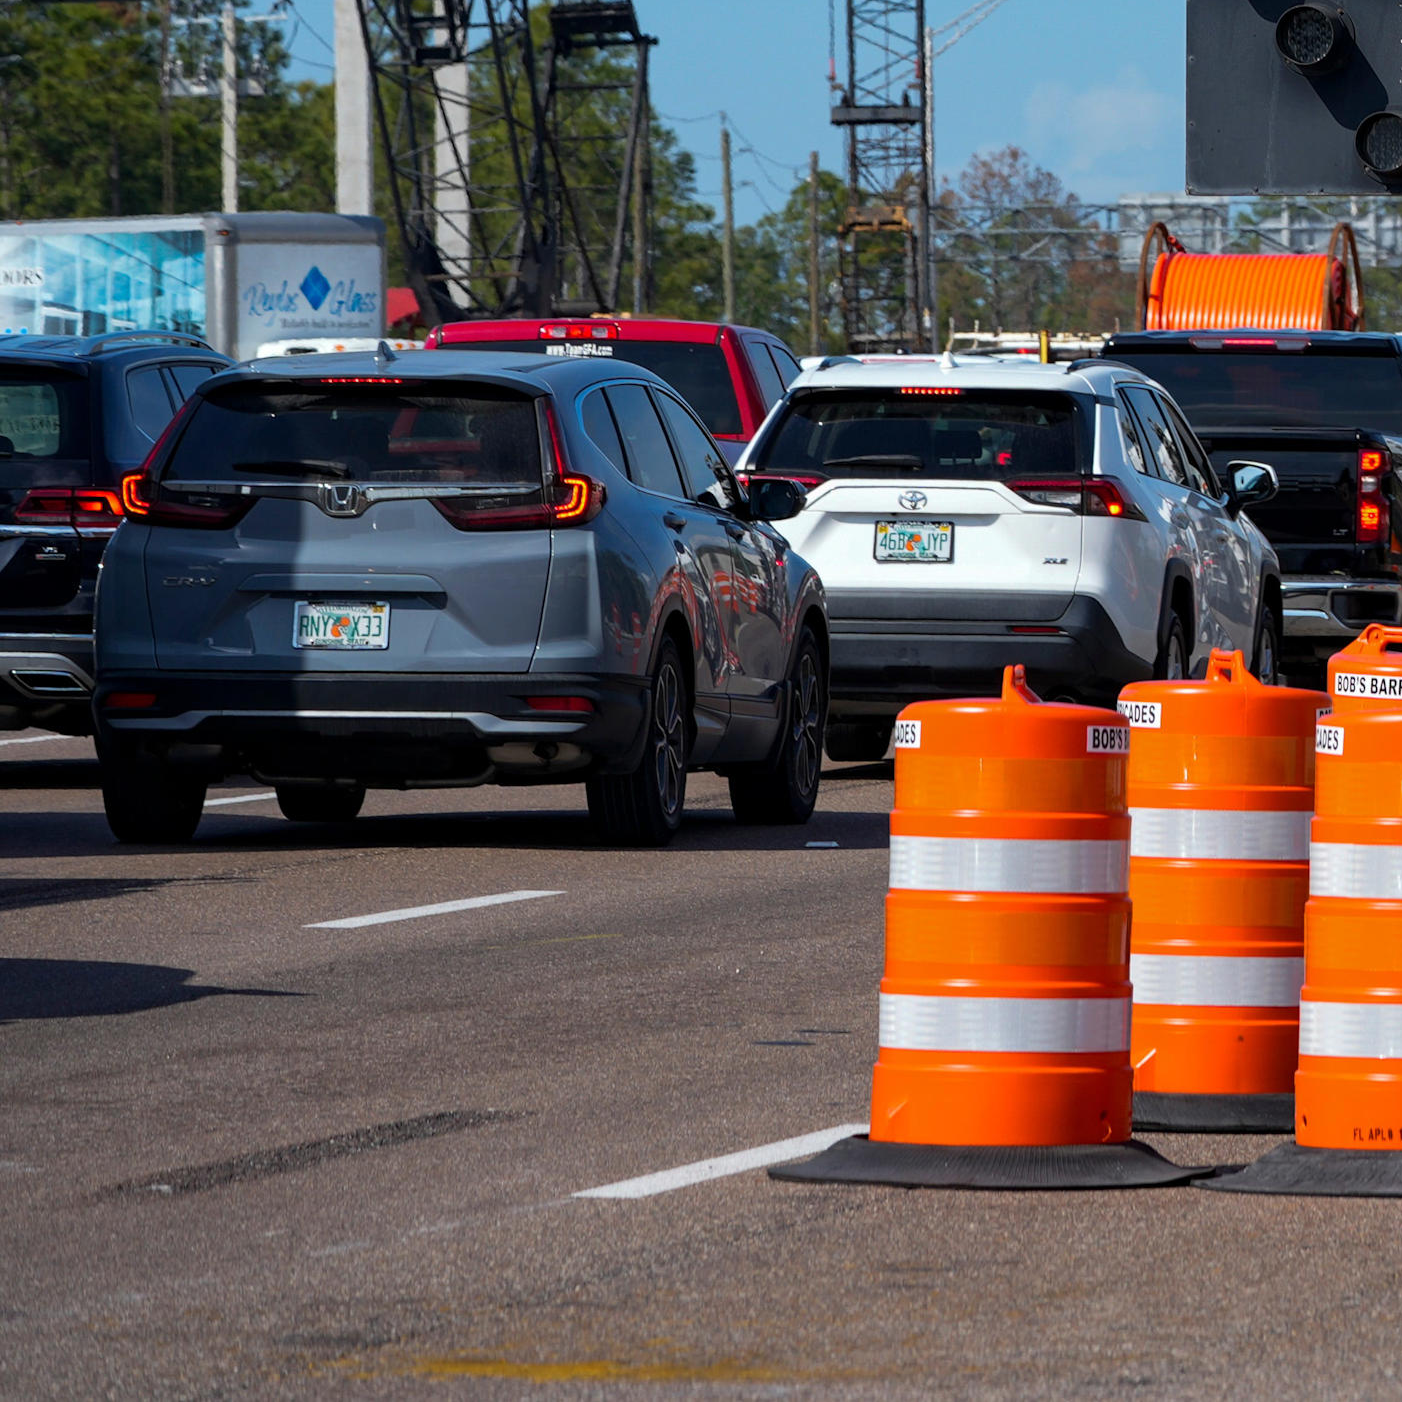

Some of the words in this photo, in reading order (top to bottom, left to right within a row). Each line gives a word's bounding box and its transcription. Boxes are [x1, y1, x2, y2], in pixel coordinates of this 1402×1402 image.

[926, 532, 948, 551] JYP
[1042, 557, 1069, 565] XLE
[300, 615, 331, 637] RNY
[351, 615, 382, 637] X33
[1337, 673, 1366, 694] BOB'S
[1091, 727, 1123, 750] BOB'S
